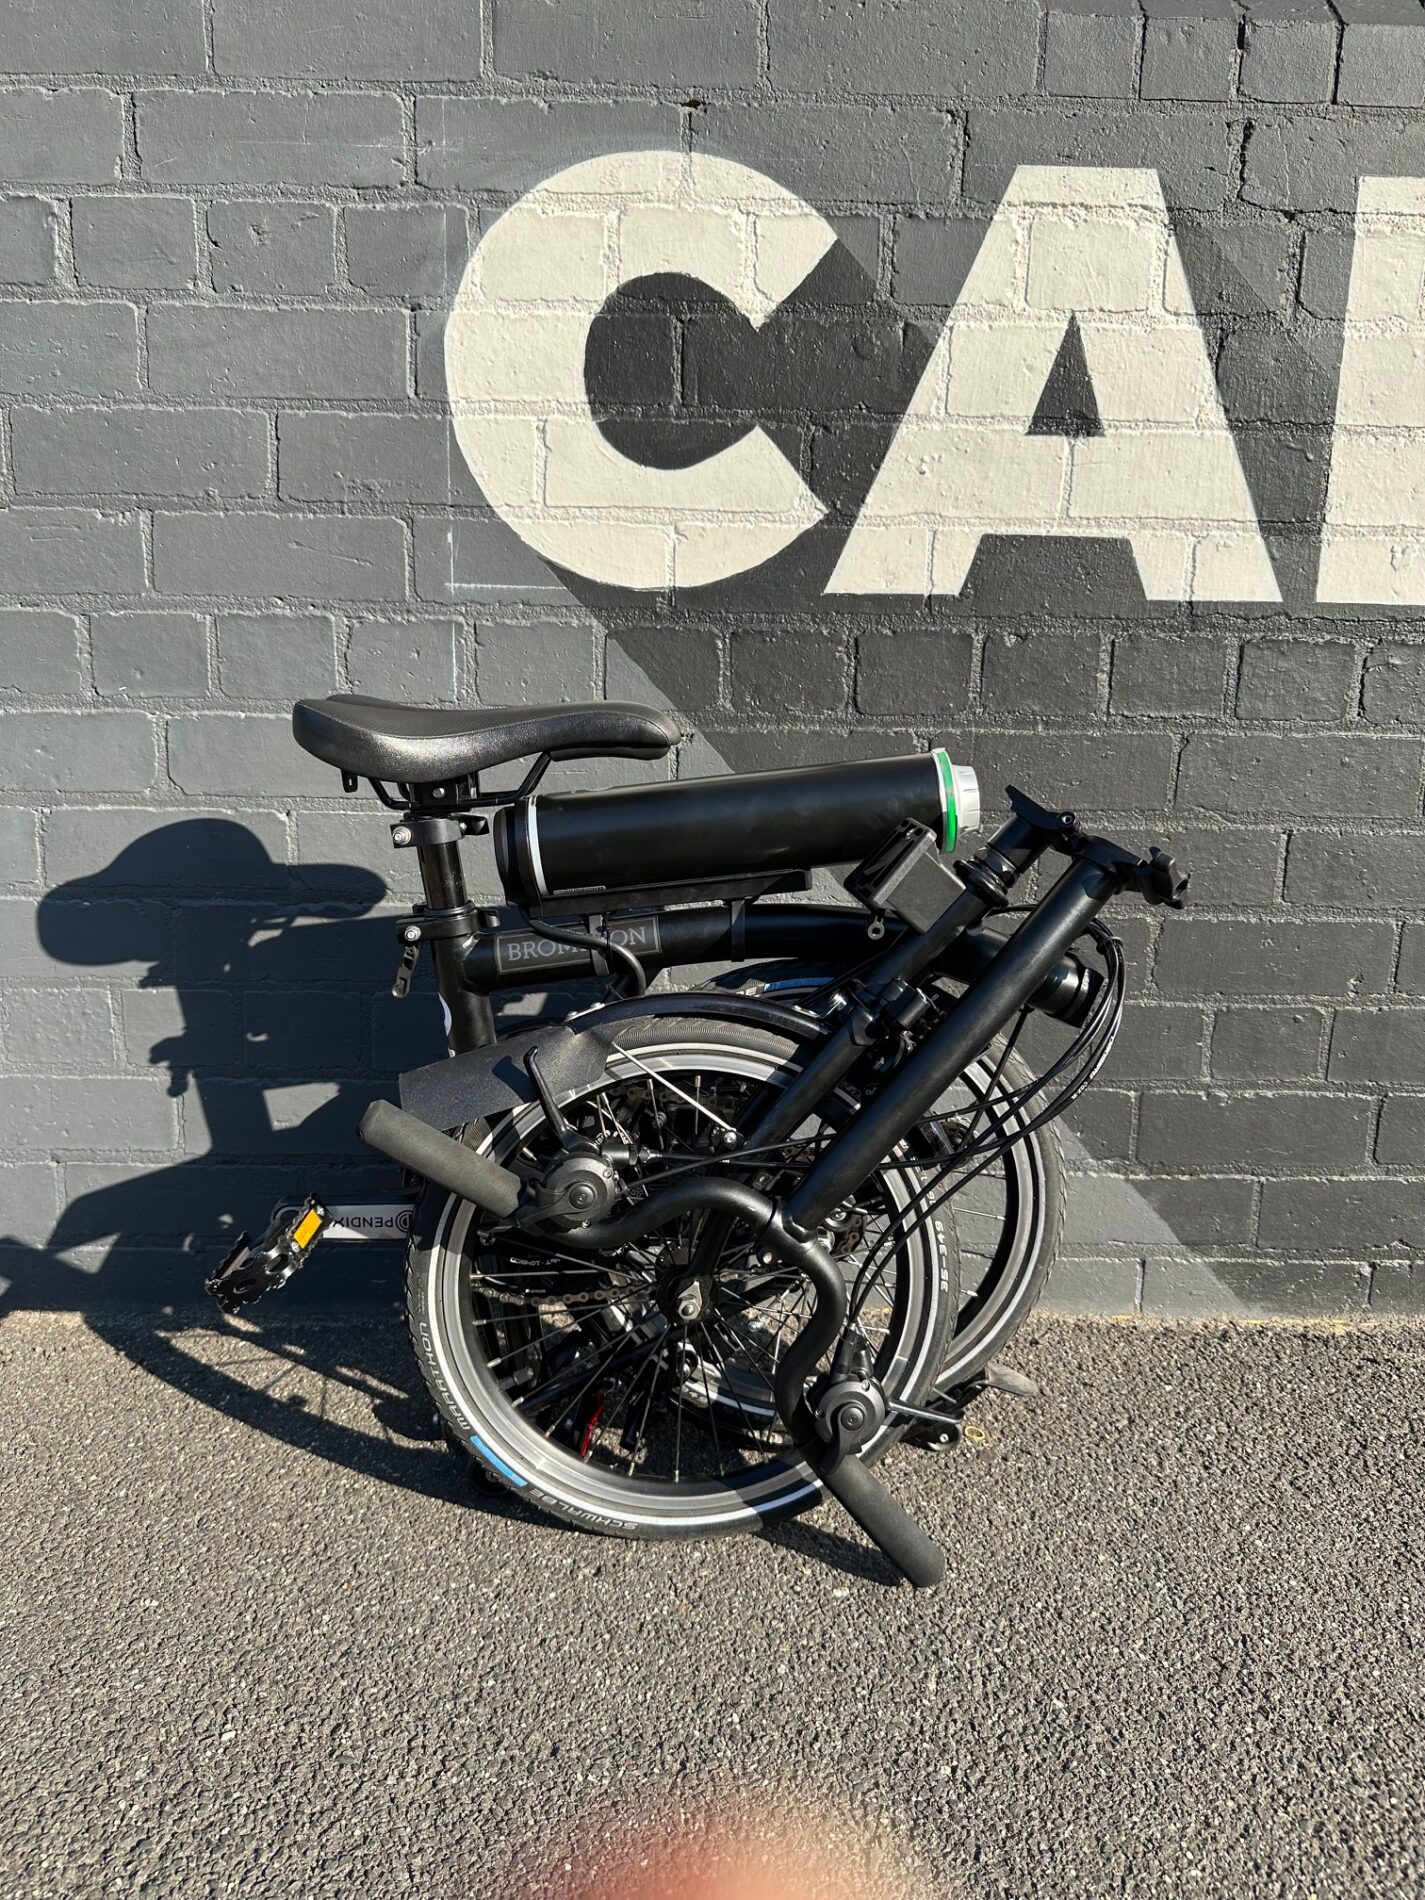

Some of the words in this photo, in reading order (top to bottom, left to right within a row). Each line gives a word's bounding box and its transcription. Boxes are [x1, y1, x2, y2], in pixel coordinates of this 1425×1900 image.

[507, 926, 647, 962] BROMON
[332, 1216, 394, 1228] PENDIX
[934, 1220, 949, 1293] 35-349
[418, 1321, 471, 1432] MARATHON
[529, 1487, 639, 1531] SCHWALBE
